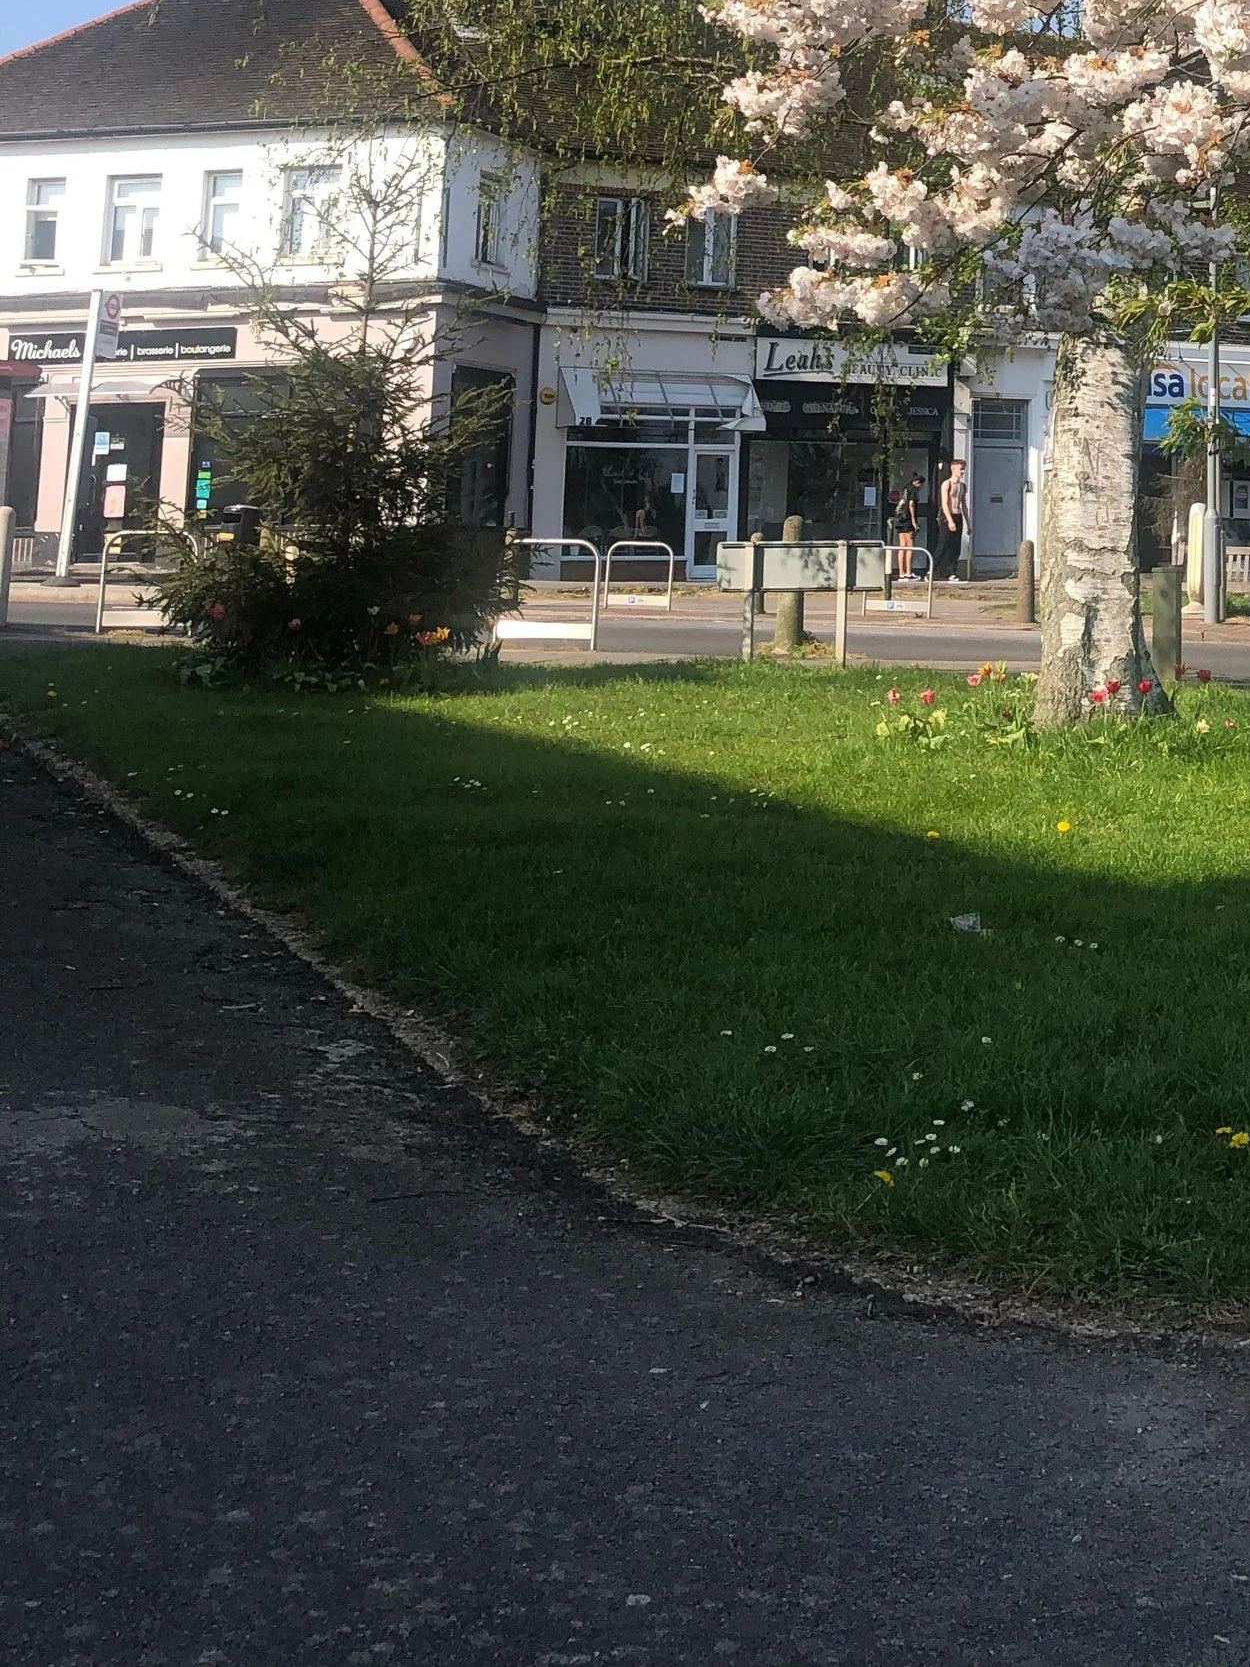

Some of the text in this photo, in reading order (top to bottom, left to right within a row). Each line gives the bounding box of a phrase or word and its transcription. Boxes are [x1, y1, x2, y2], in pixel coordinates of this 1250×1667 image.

[11, 339, 81, 360] Michaels
[137, 345, 174, 355] brasserie
[180, 344, 231, 354] boulangerie
